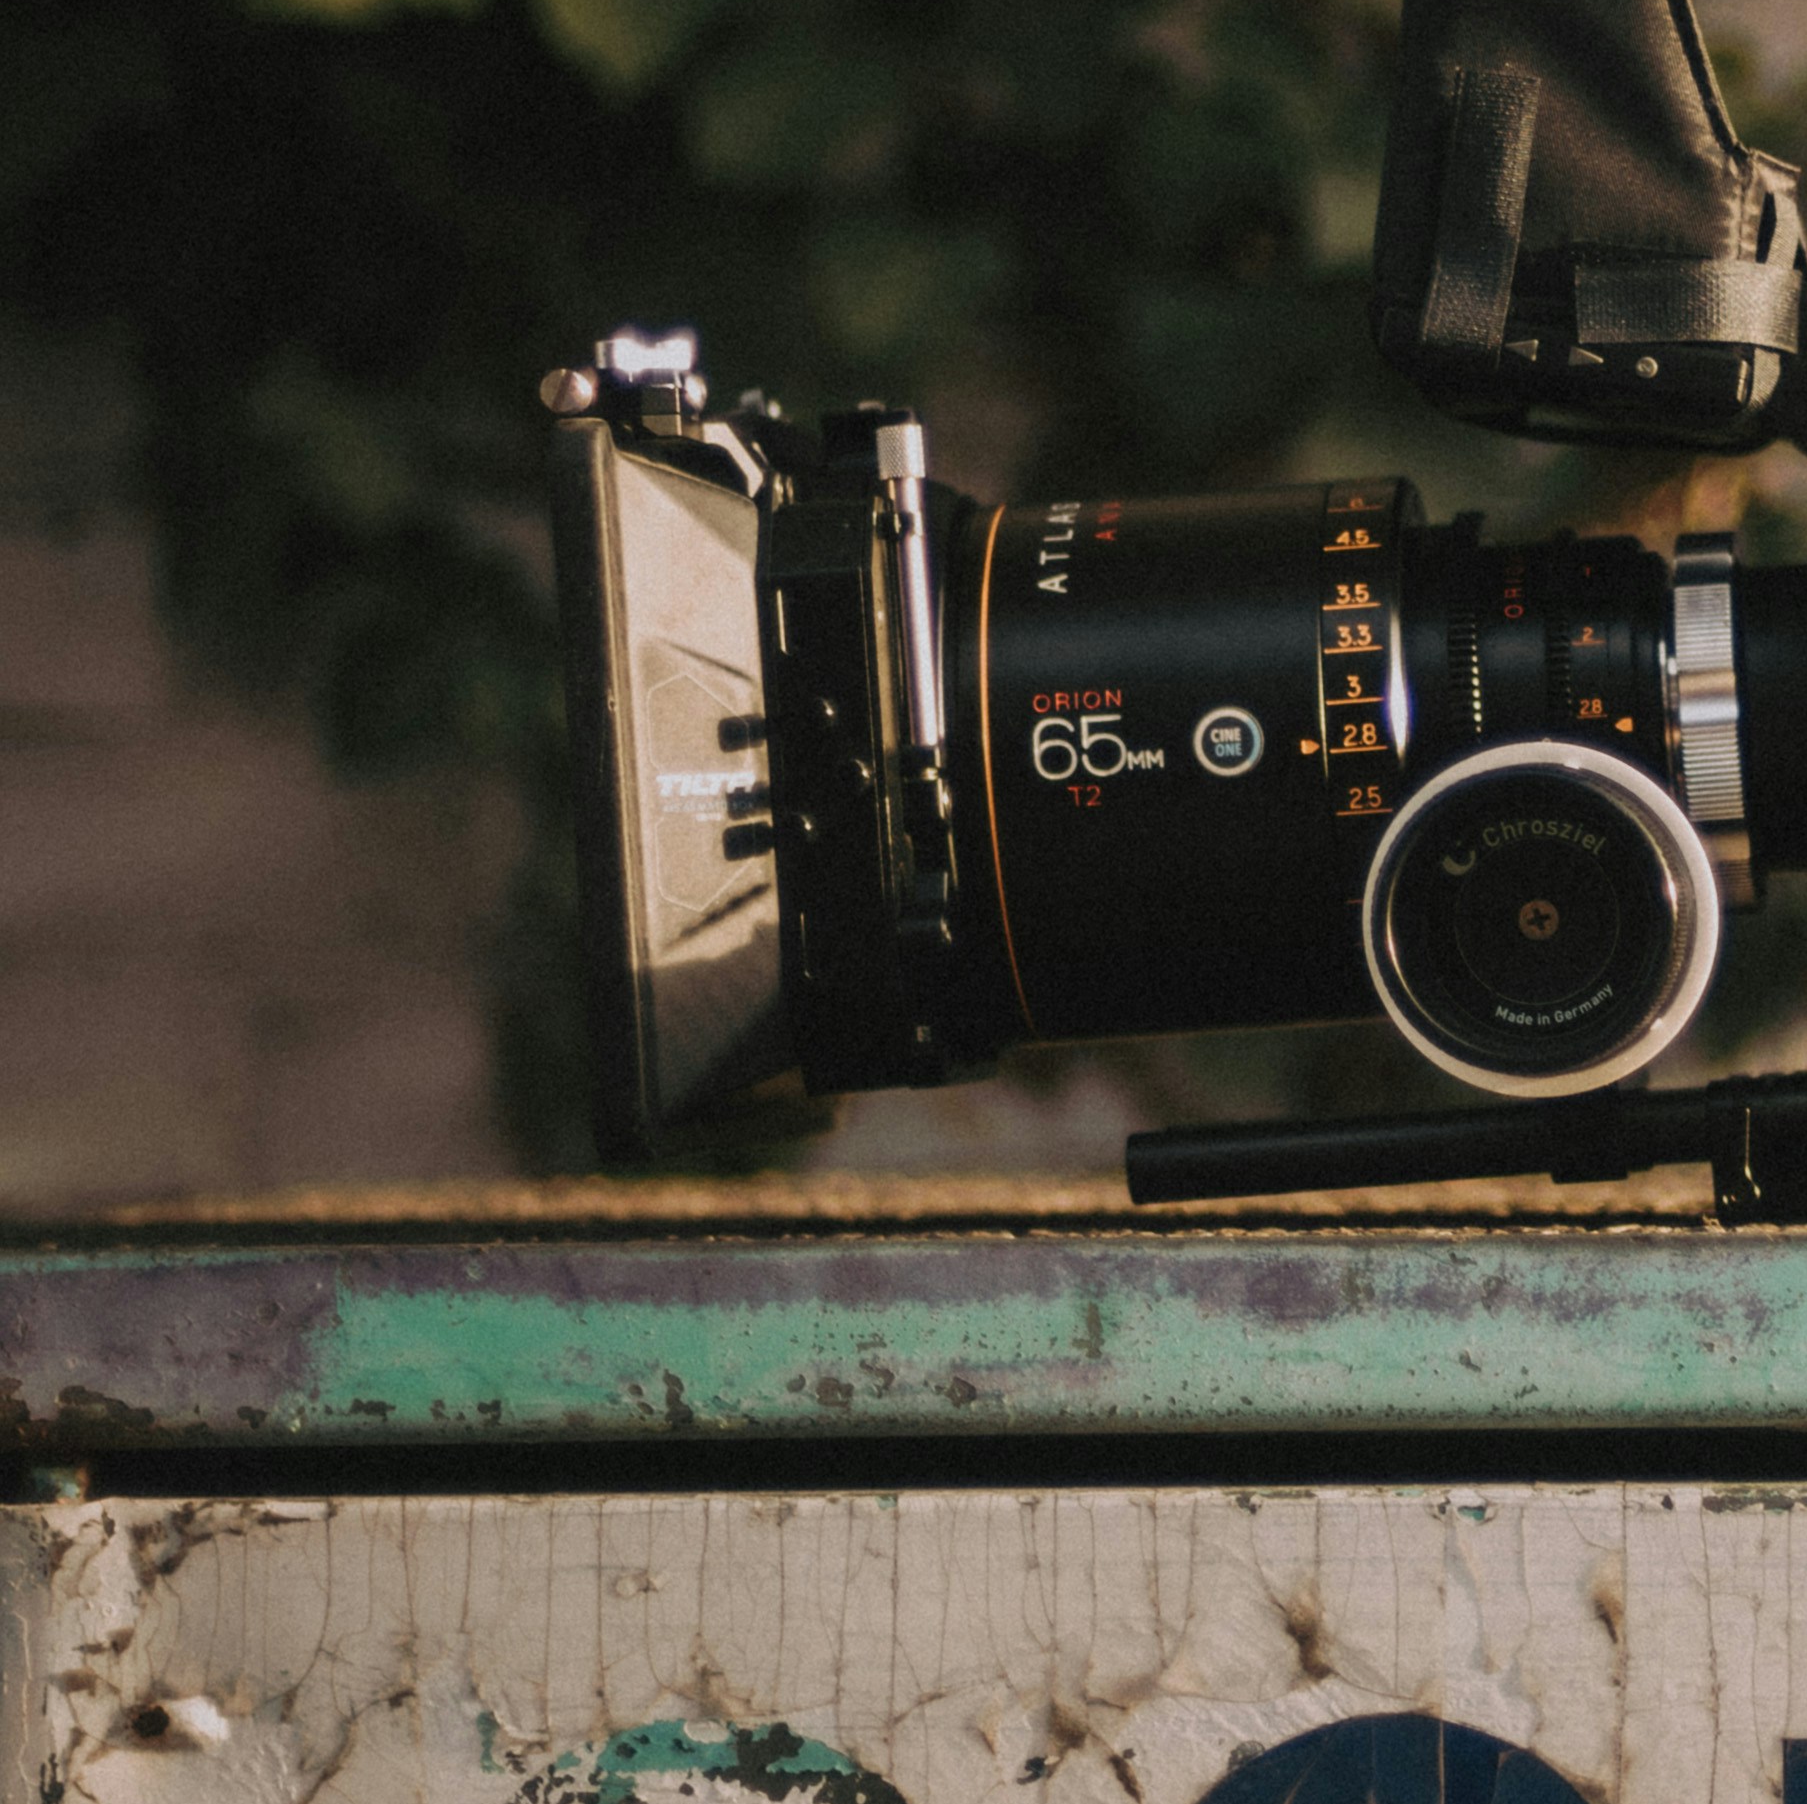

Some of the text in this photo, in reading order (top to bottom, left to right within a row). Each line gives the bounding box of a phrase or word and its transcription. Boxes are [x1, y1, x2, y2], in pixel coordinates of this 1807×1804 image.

[1037, 501, 1081, 594] ATLAS
[1336, 529, 1370, 545] 4.5
[1336, 583, 1370, 604] 3.5
[1338, 624, 1372, 647] 3.3
[1583, 626, 1594, 642] 2
[1347, 675, 1362, 697] 3
[1032, 689, 1123, 714] ORION
[1210, 727, 1242, 744] CINE
[1343, 722, 1377, 747] 2.8
[1215, 743, 1242, 758] ONE
[656, 772, 756, 797] TILTA
[1067, 785, 1102, 808] T2
[1349, 785, 1382, 809] 2.5
[1482, 819, 1607, 856] Chrosziel
[1495, 983, 1614, 1026] Made in Germany
